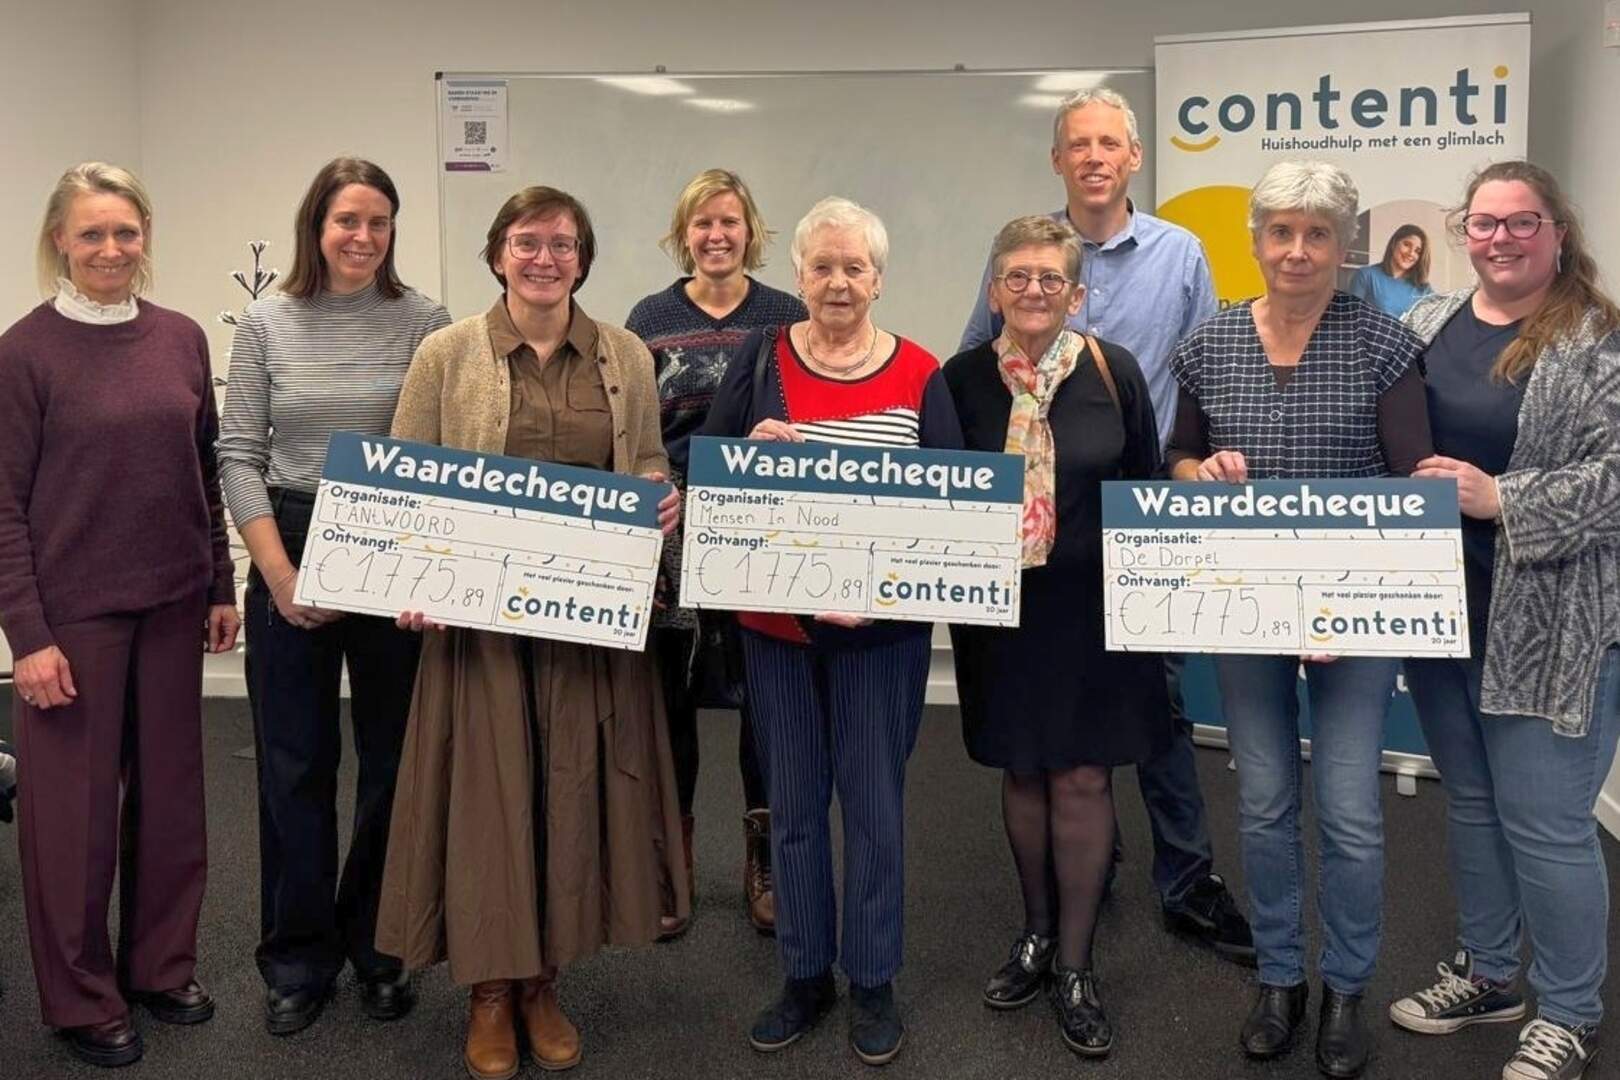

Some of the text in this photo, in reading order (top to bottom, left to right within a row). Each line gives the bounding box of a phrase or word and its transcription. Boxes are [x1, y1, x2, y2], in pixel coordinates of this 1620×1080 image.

[1178, 65, 1509, 135] contenti
[1261, 131, 1505, 152] Huishoudhulp met een glimlach
[361, 441, 641, 516] Waardecheque
[720, 444, 995, 497] Waardecheque
[331, 485, 421, 509] Organisatie:
[698, 490, 784, 506] Organisatie:
[1132, 485, 1425, 526] Waardecheque
[700, 505, 839, 527] Mensen In Nood
[322, 528, 400, 552] Ontvangt:
[697, 532, 769, 551] Ontvangt:
[1114, 532, 1202, 547] Organisatie:
[1120, 547, 1220, 567] De Dorpel
[879, 577, 1010, 606] contenti
[1117, 574, 1191, 590] Ontvangt:
[507, 595, 640, 629] contenti
[1312, 610, 1456, 635] contenti
[624, 630, 636, 638] jaar
